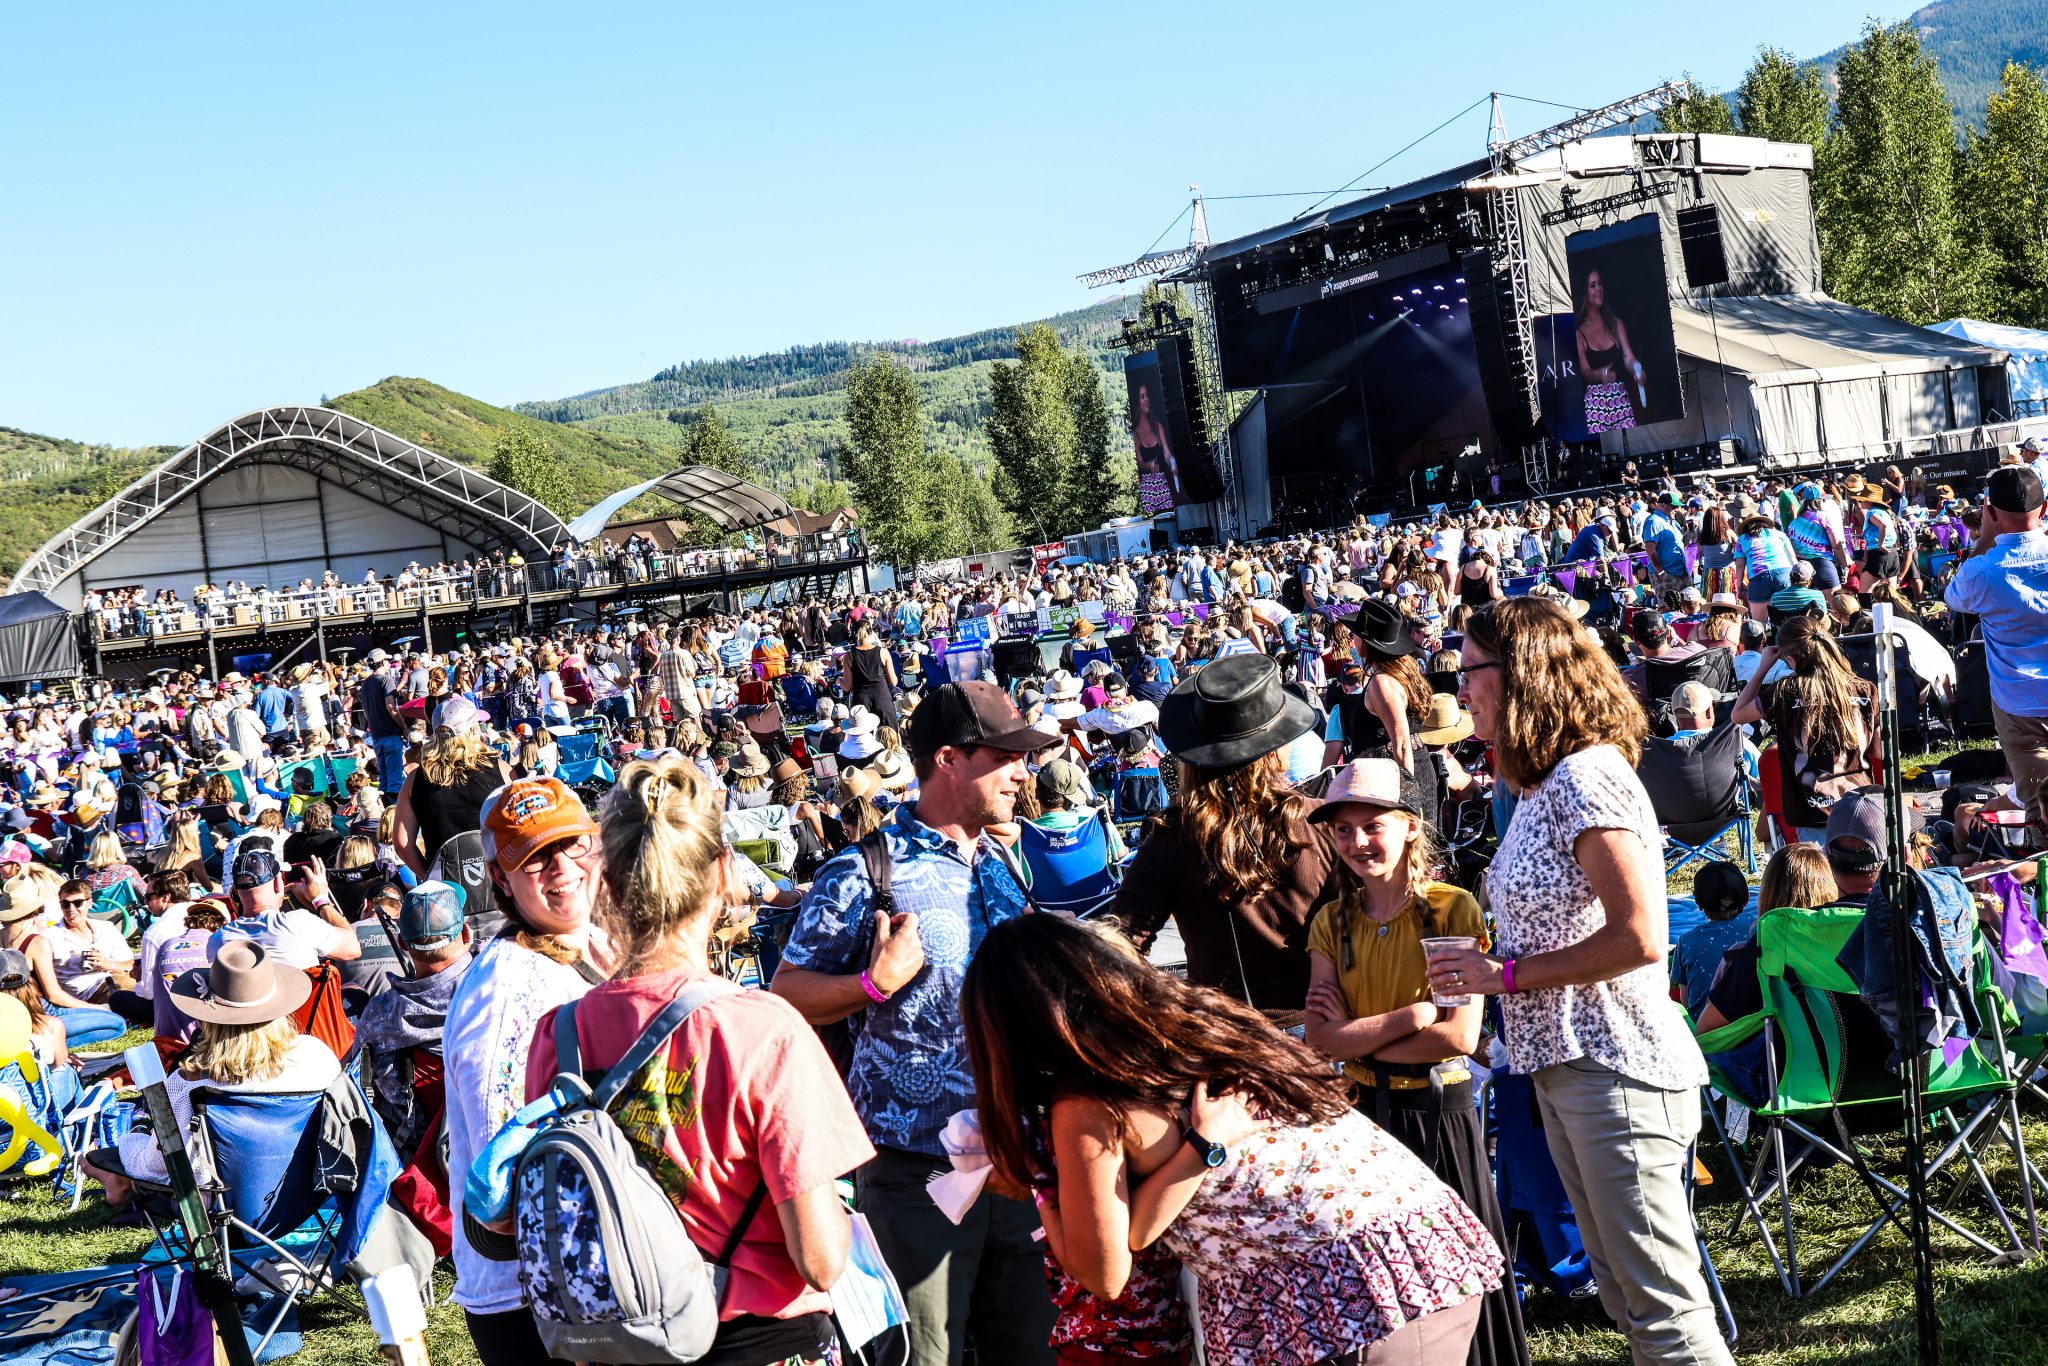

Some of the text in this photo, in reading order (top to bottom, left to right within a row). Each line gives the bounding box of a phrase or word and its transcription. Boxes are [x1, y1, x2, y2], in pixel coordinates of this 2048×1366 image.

[1333, 280, 1350, 291] aspen
[1350, 270, 1379, 286] snowmass
[1929, 471, 1943, 480] Our
[1943, 469, 1969, 478] mission.
[1014, 612, 1032, 620] TRASH
[1051, 607, 1078, 617] COMPOST
[957, 616, 987, 627] RECYCLING
[462, 856, 484, 864] NEMO
[160, 955, 207, 966] BILLABONG
[636, 1125, 651, 1143] the
